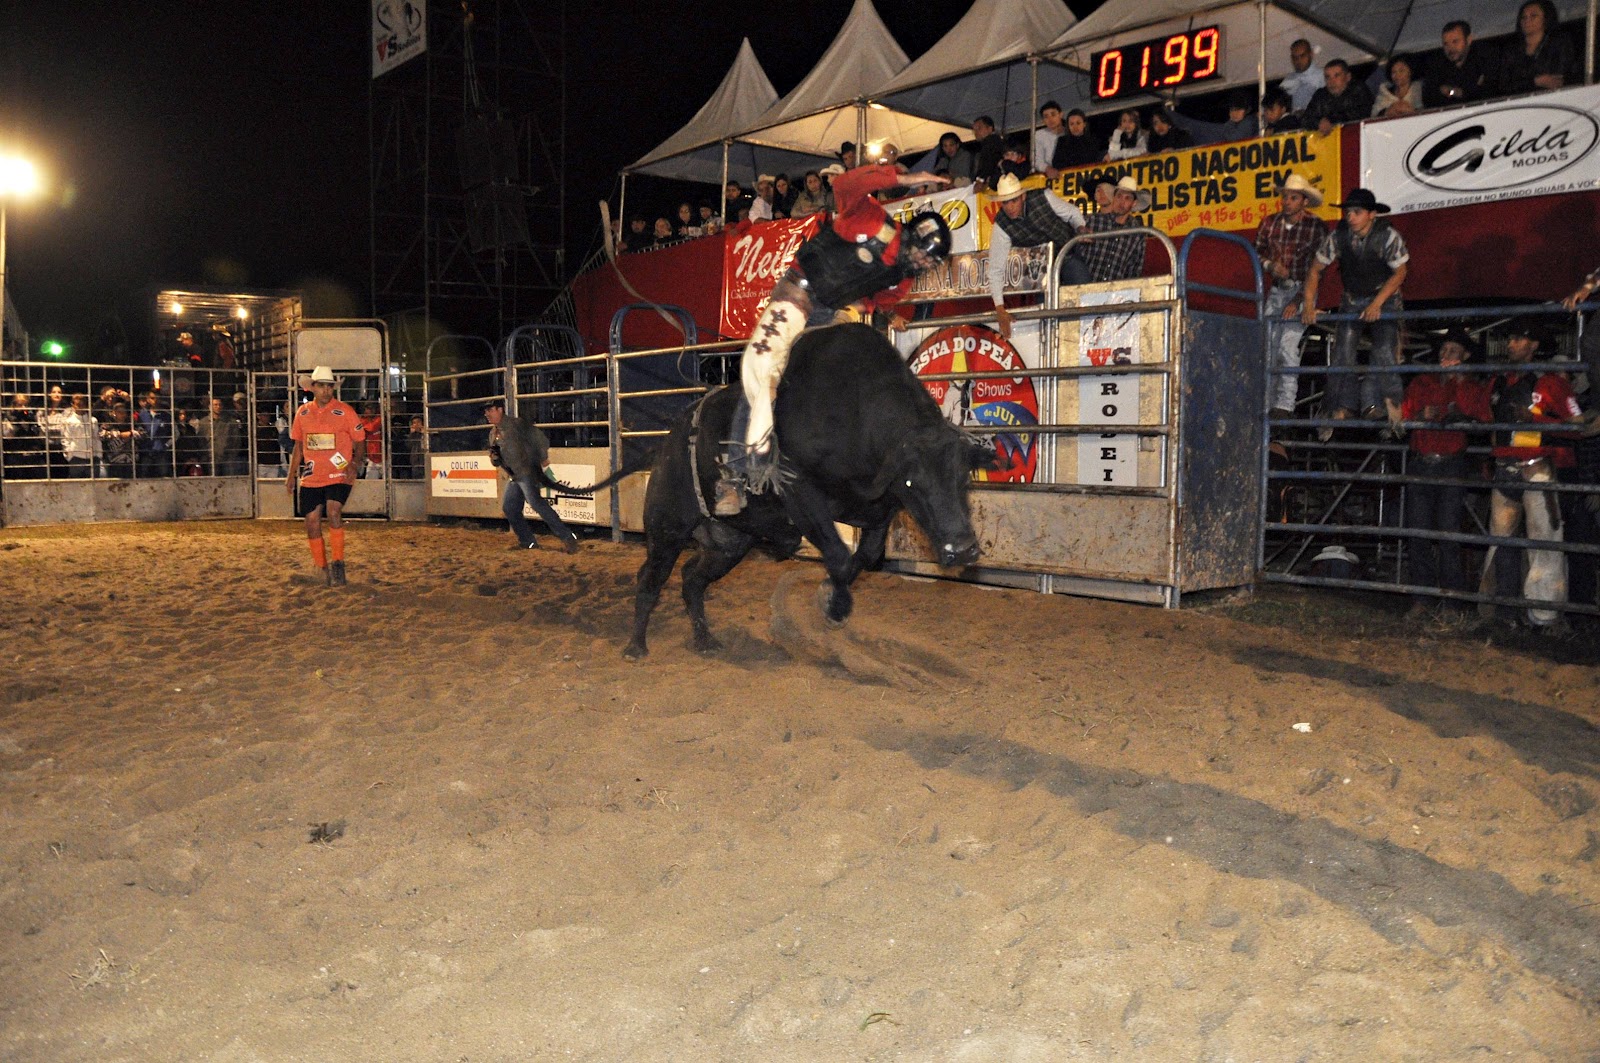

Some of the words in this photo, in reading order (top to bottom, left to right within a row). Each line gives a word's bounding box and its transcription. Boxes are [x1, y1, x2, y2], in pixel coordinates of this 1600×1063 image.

[1098, 27, 1219, 98] 01.99
[1191, 135, 1315, 179] NACIONAL
[1417, 125, 1574, 177] Gilda
[1512, 152, 1569, 168] MODAS
[1417, 200, 1445, 210] TODOS
[1447, 195, 1482, 206] FOSSEM
[1484, 193, 1497, 201] NO
[1499, 188, 1532, 198] MUNDO
[1534, 183, 1566, 193] IGUAIS
[1568, 182, 1575, 190] A
[1578, 179, 1599, 188] VOC
[958, 254, 1023, 290] RODIO
[909, 340, 950, 375] ESTA
[953, 336, 976, 353] DO
[977, 382, 1012, 397] Shows
[993, 405, 1029, 444] JULO
[451, 461, 479, 470] COLITUR
[564, 500, 588, 508] Florestal
